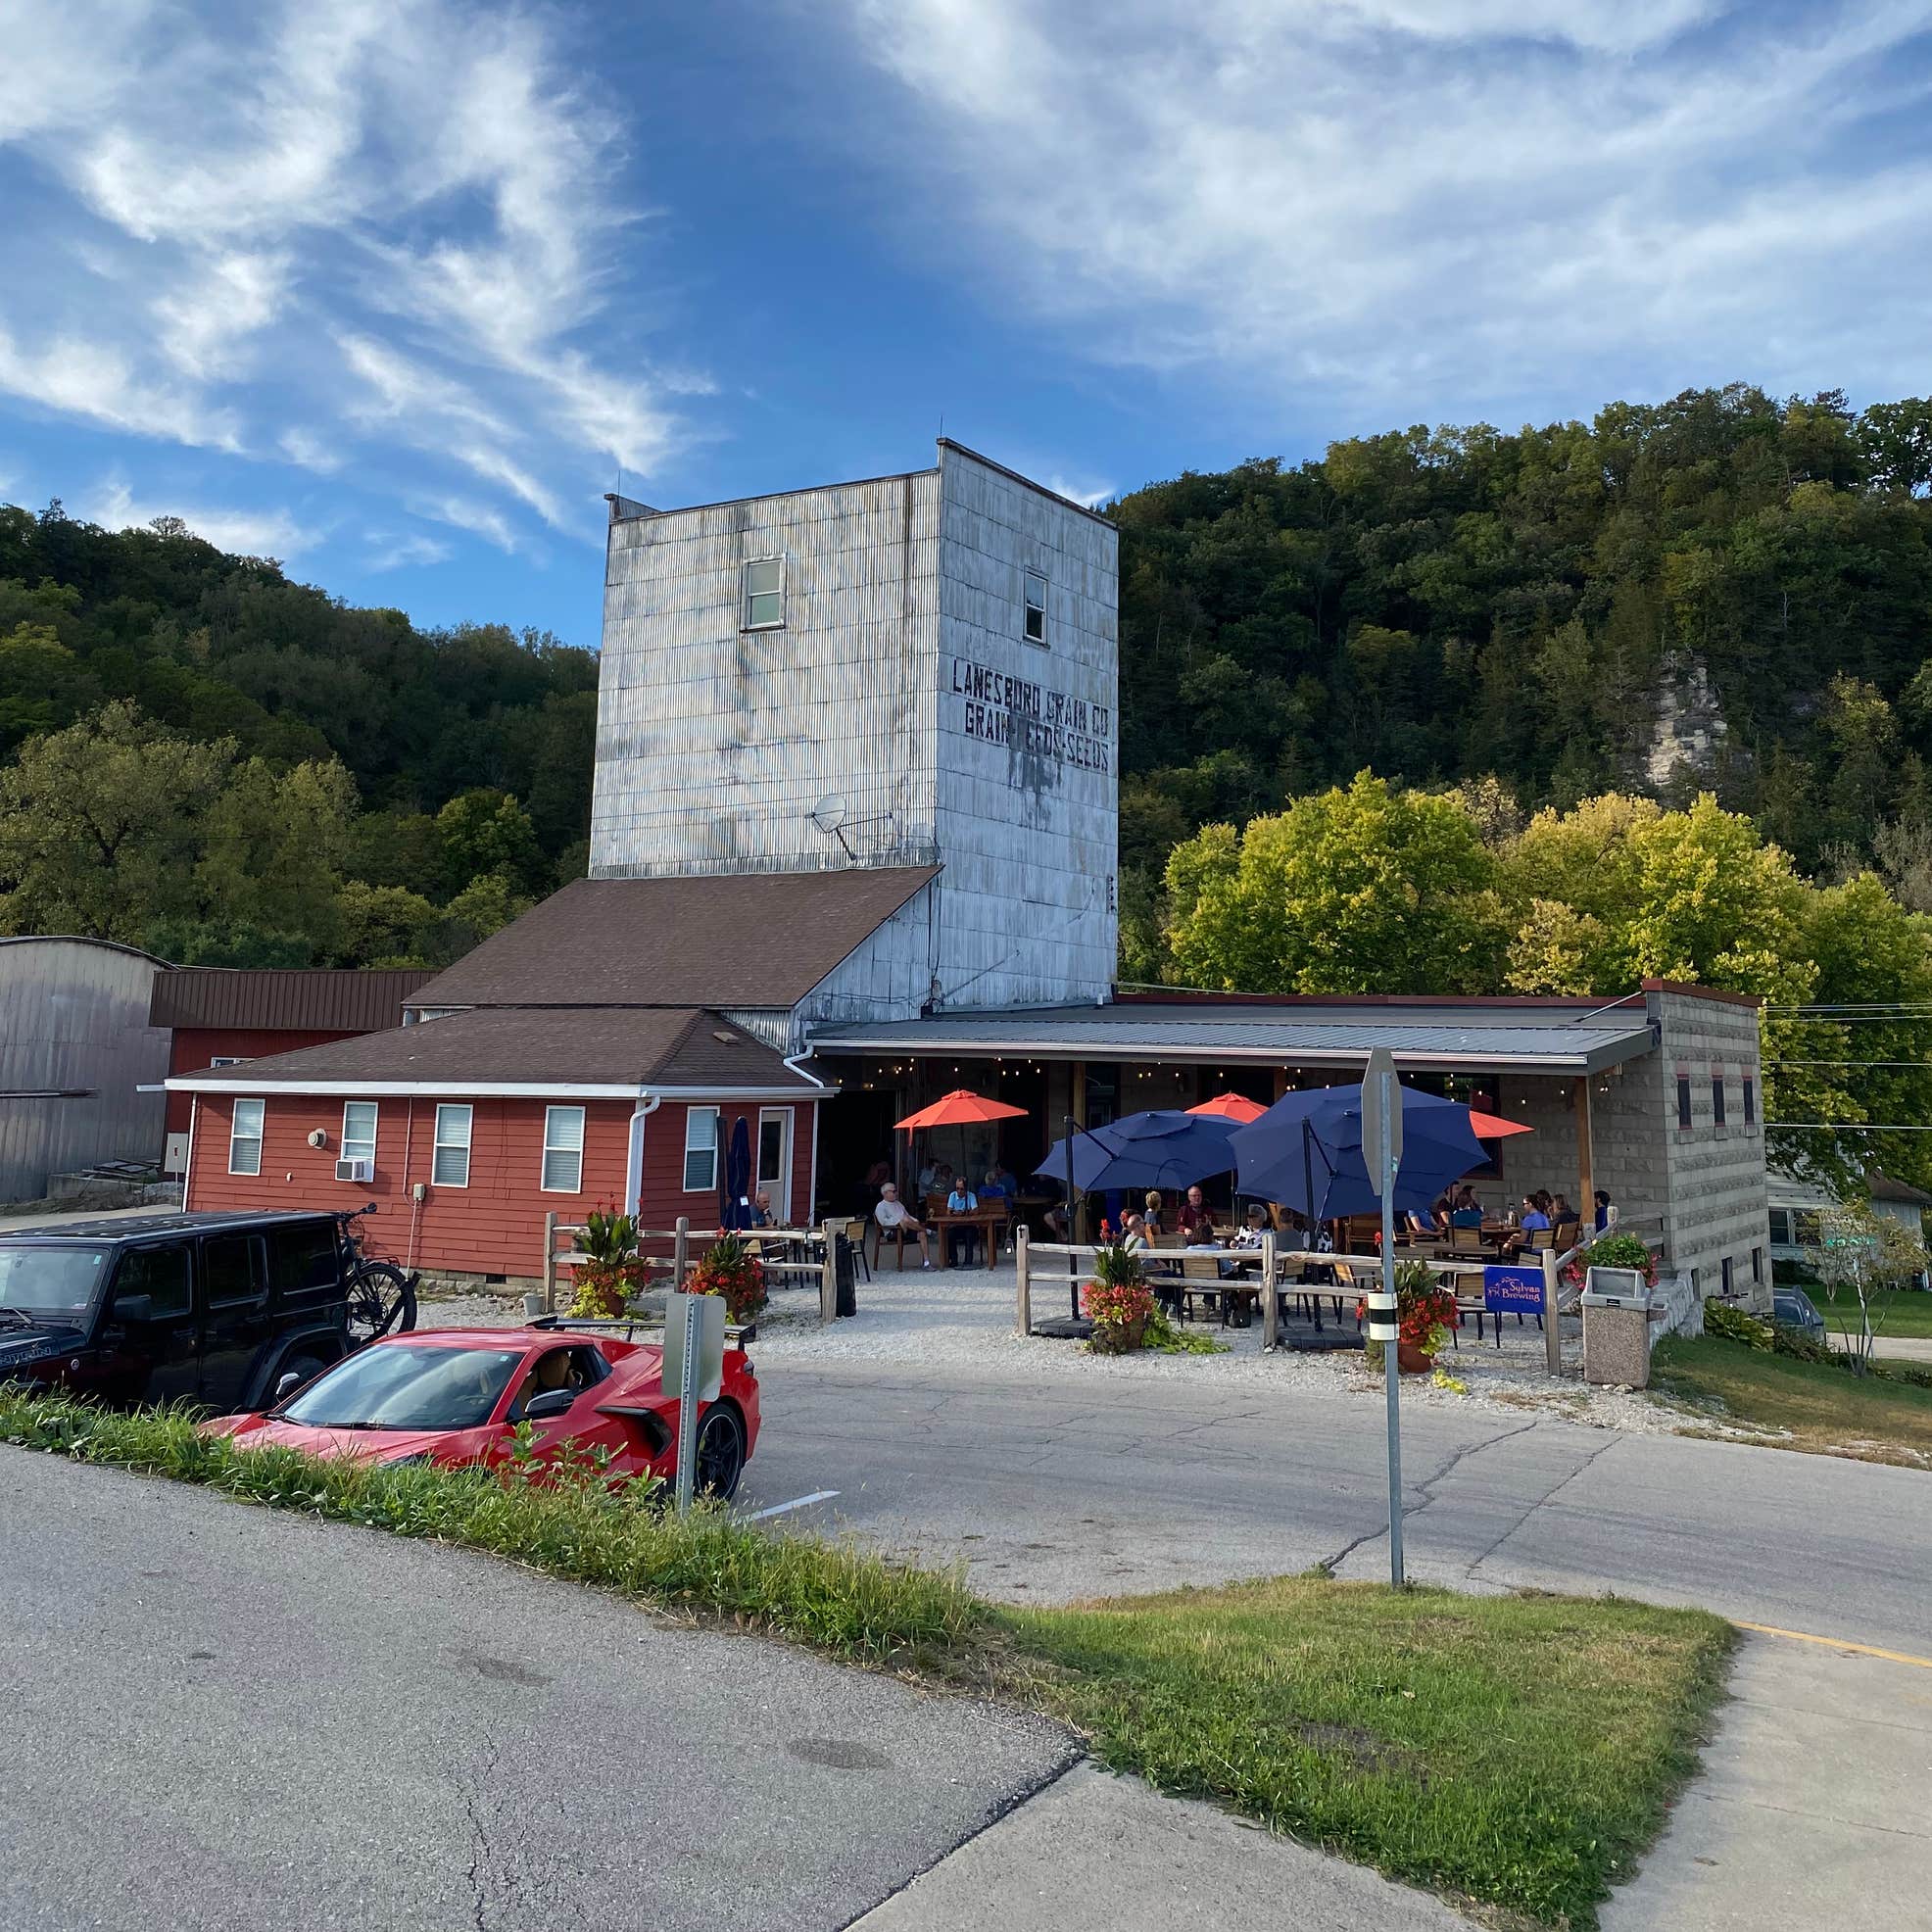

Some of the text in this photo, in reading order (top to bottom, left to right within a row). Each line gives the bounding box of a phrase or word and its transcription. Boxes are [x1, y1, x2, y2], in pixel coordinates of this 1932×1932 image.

[953, 658, 1040, 715] LANESBORO
[1046, 691, 1087, 731] GRAIN
[1502, 1287, 1541, 1302] Brewing
[1510, 1281, 1541, 1293] Sylvan
